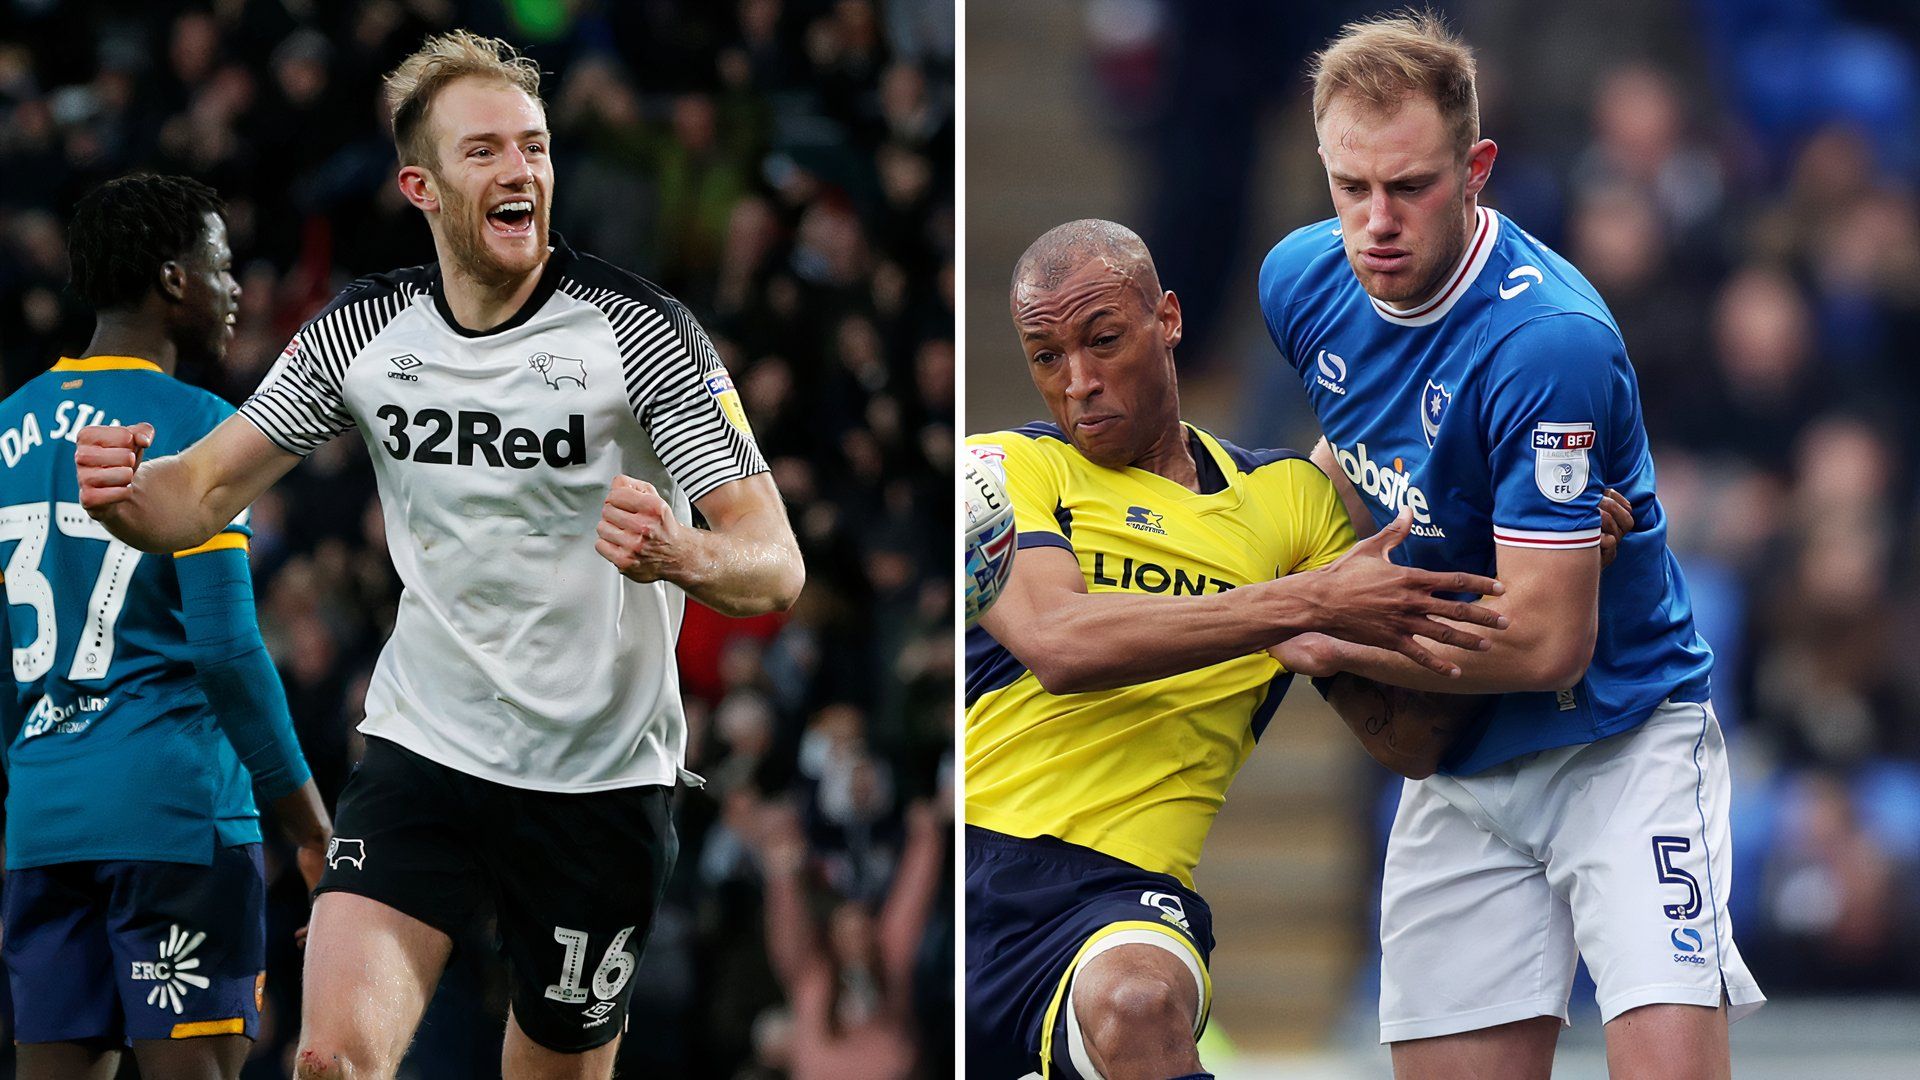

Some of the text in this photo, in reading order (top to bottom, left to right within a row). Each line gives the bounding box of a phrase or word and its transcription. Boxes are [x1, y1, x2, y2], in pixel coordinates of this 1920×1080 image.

[0, 400, 121, 469] DA SI
[375, 404, 587, 470] 32Red
[1536, 432, 1592, 449] sky BET
[965, 463, 1001, 511] mit
[1554, 485, 1571, 494] EFL
[0, 501, 144, 682] 37
[1652, 835, 1702, 920] 5
[131, 961, 171, 980] ERC
[544, 926, 636, 1004] 16
